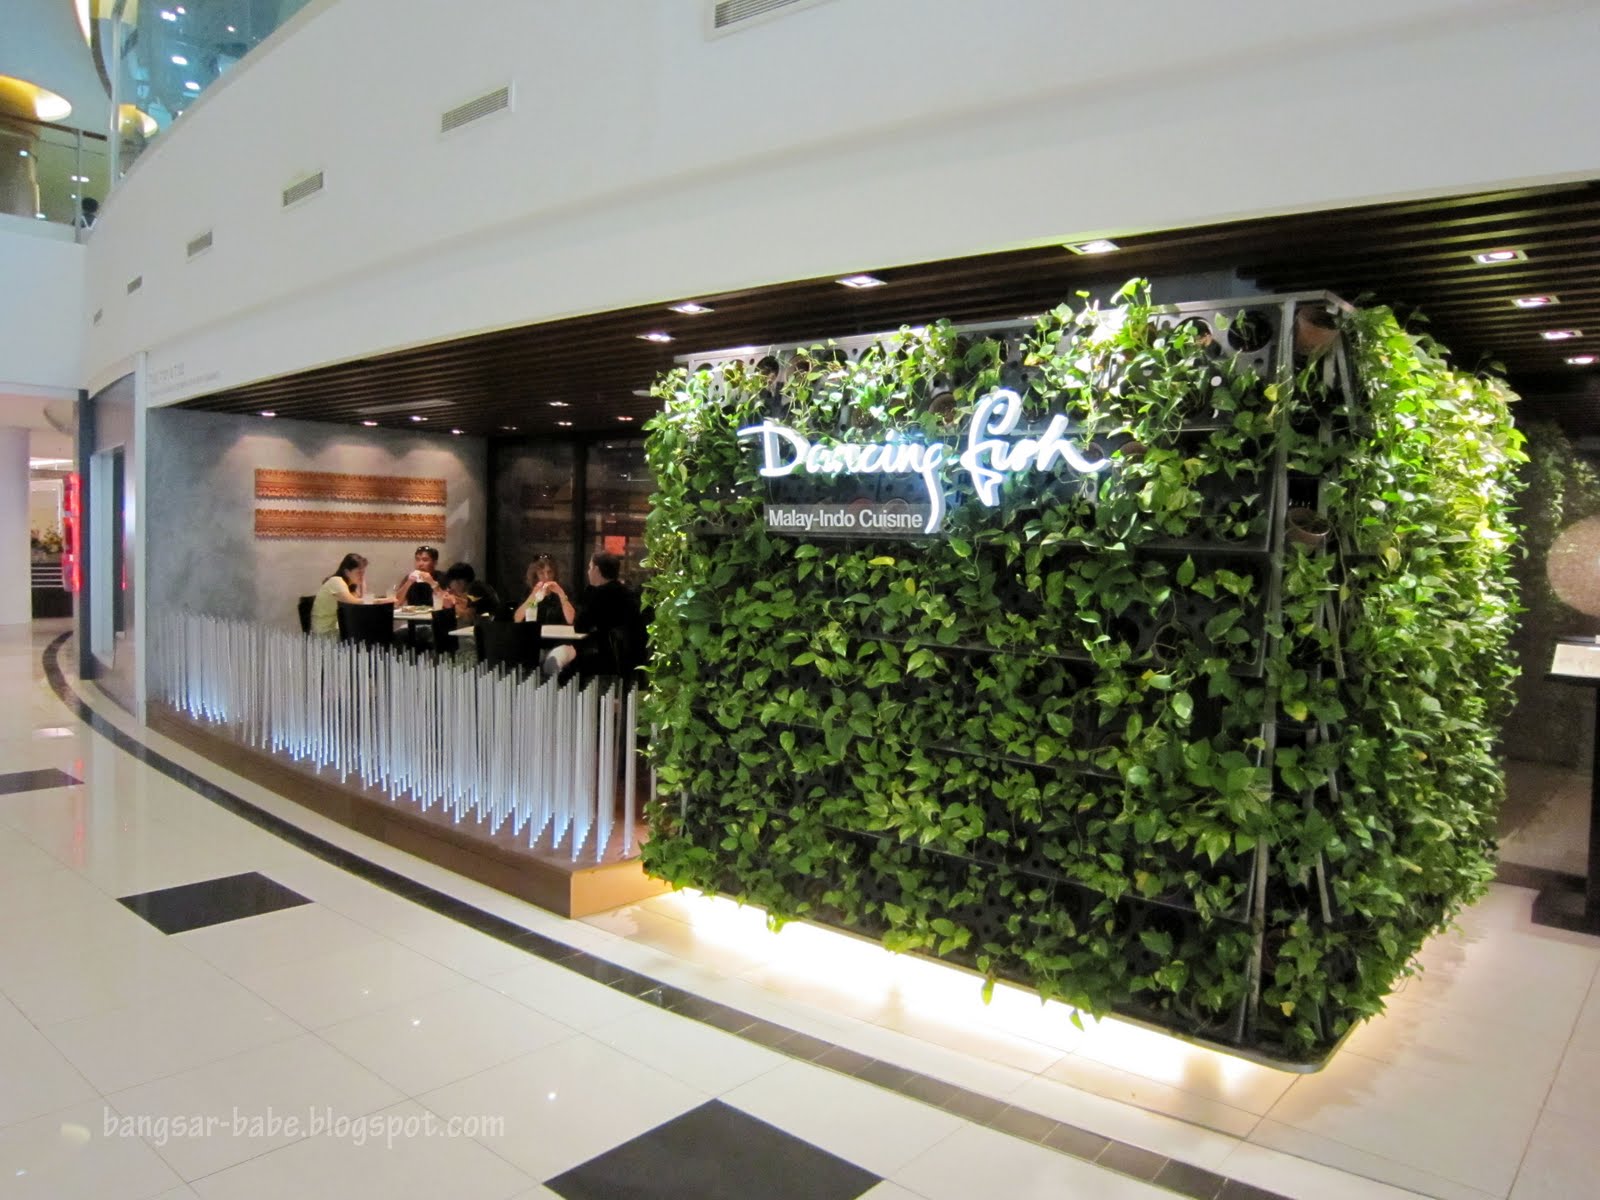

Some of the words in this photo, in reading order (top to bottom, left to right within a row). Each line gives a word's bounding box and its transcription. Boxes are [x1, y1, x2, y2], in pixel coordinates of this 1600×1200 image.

[737, 421, 945, 534] Dancing
[768, 509, 856, 531] Malay-Indo
[859, 508, 924, 530] Cuisine
